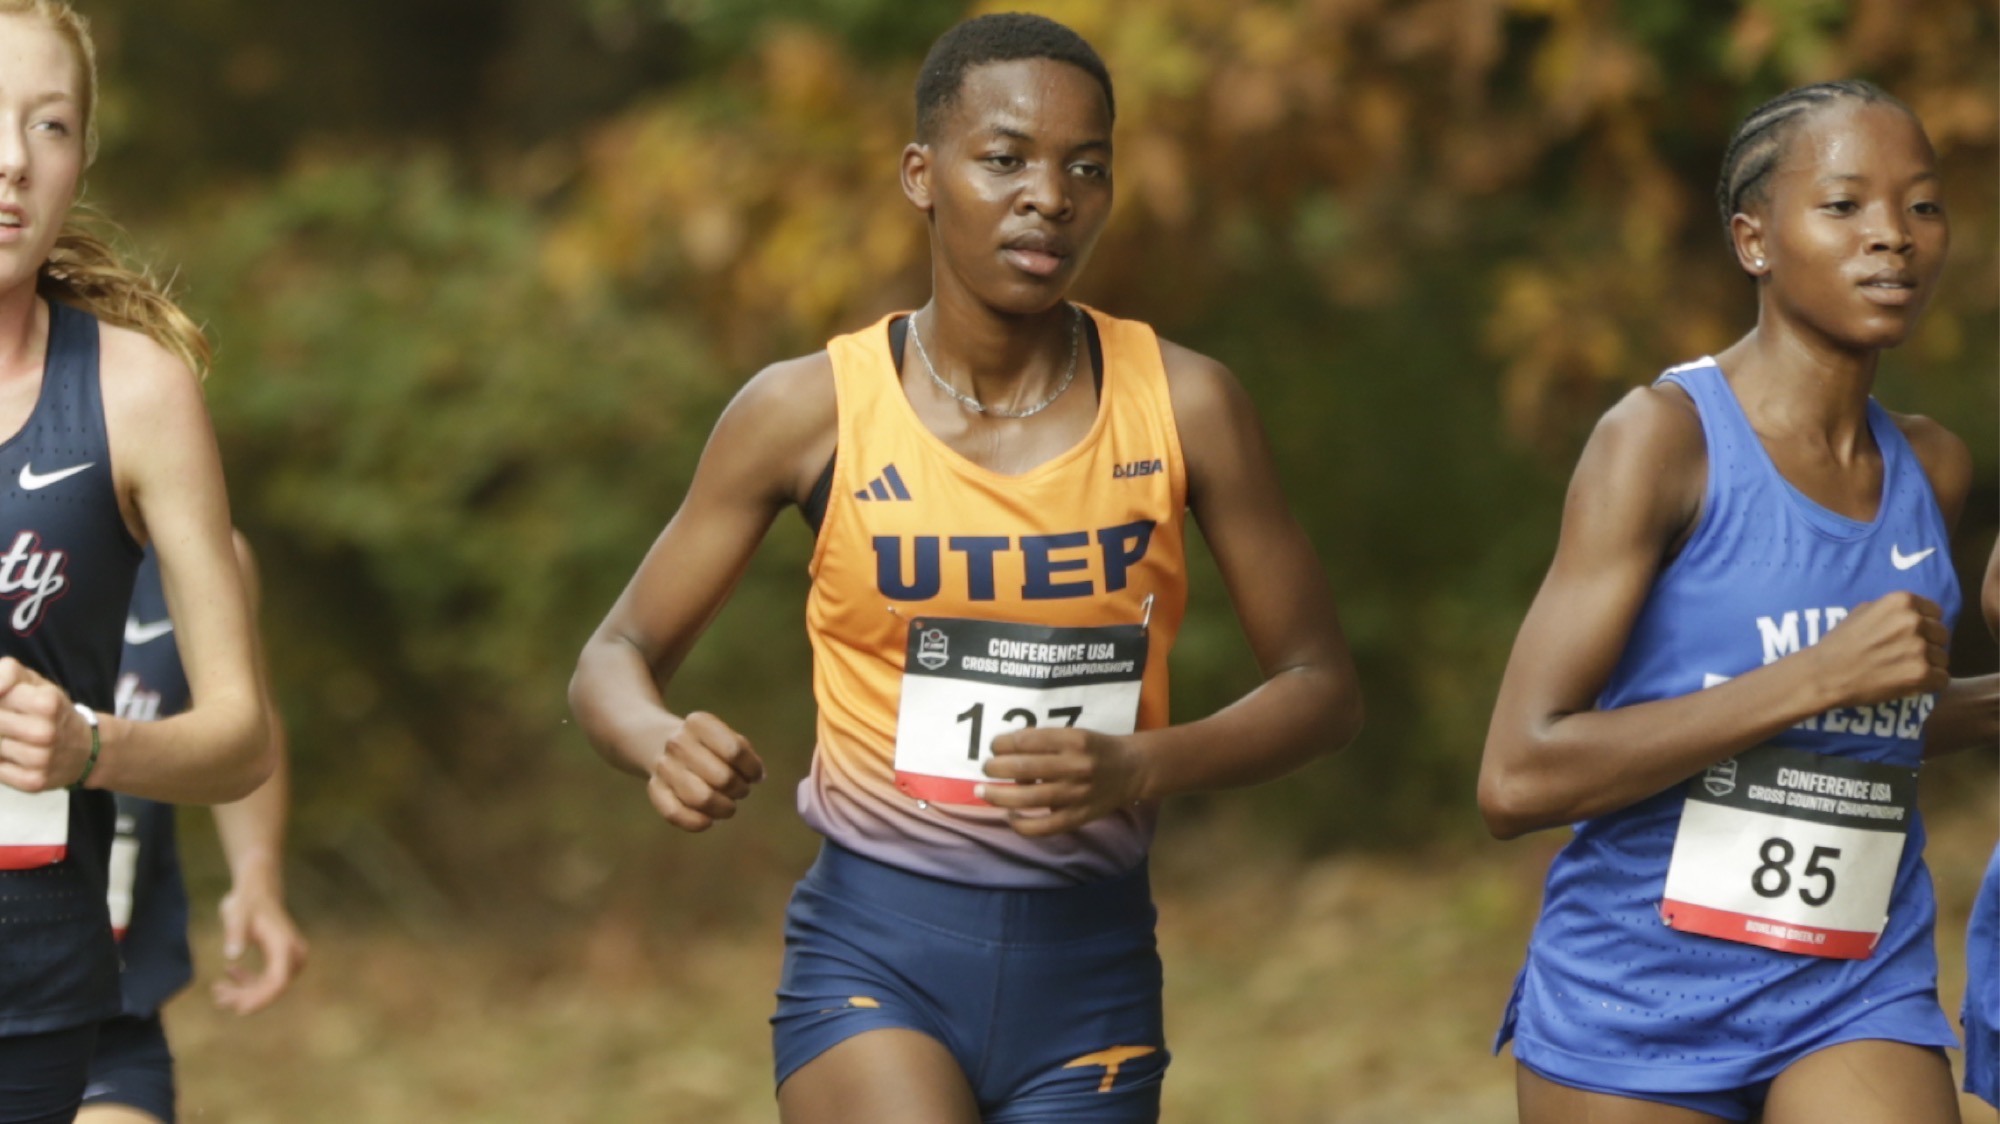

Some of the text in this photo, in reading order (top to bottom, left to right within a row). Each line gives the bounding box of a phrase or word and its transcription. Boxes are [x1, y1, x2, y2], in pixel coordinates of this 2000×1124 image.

[872, 520, 1157, 601] UTEP
[961, 656, 1134, 679] CROSS COUNTRY CHAMPIONSHIPS
[988, 638, 1115, 663] CONFERENCE USA
[1748, 784, 1905, 821] CROSS COUNTRY CHAMPIONSHIPS
[1777, 767, 1891, 802] CONFERENCE USA
[1751, 837, 1841, 907] 85
